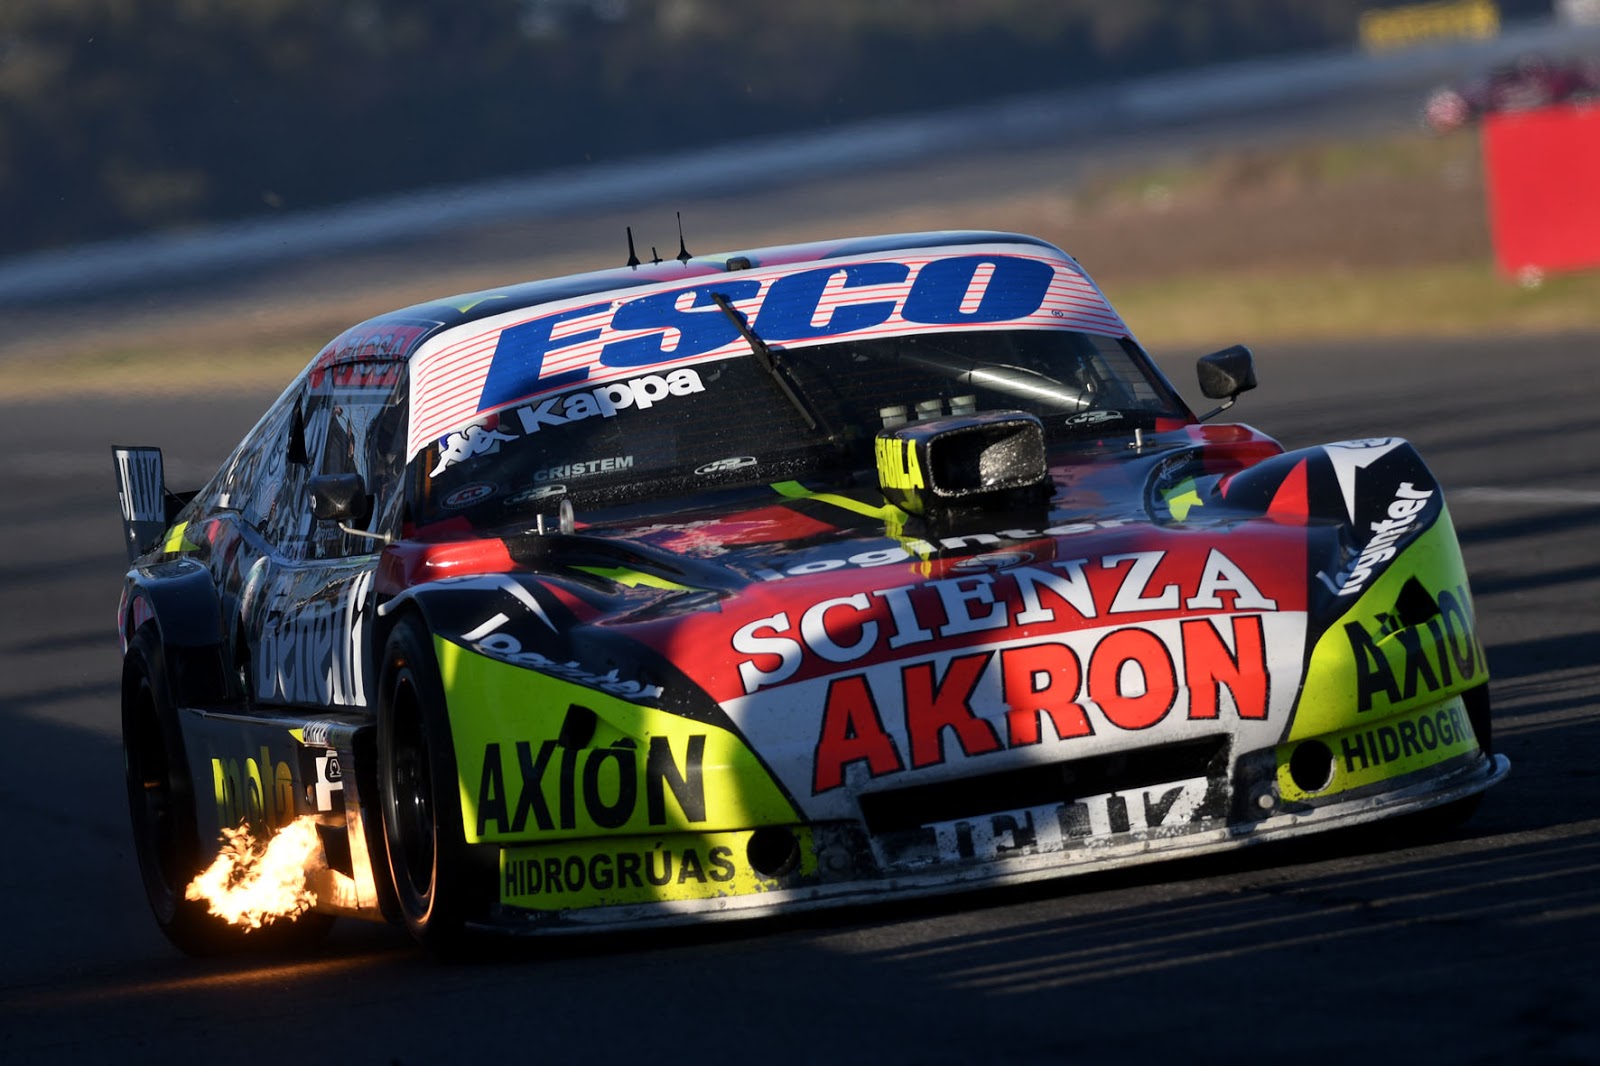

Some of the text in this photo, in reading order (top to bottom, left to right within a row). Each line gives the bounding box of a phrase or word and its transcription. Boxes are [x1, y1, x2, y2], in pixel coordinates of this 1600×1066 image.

[476, 255, 1055, 414] ESCO
[516, 368, 706, 435] Kappa
[534, 456, 633, 482] CRISTEM
[731, 547, 1280, 695] SCIENZA
[811, 614, 1270, 797] AKRON
[505, 840, 736, 898] HIDROGRÚAS
